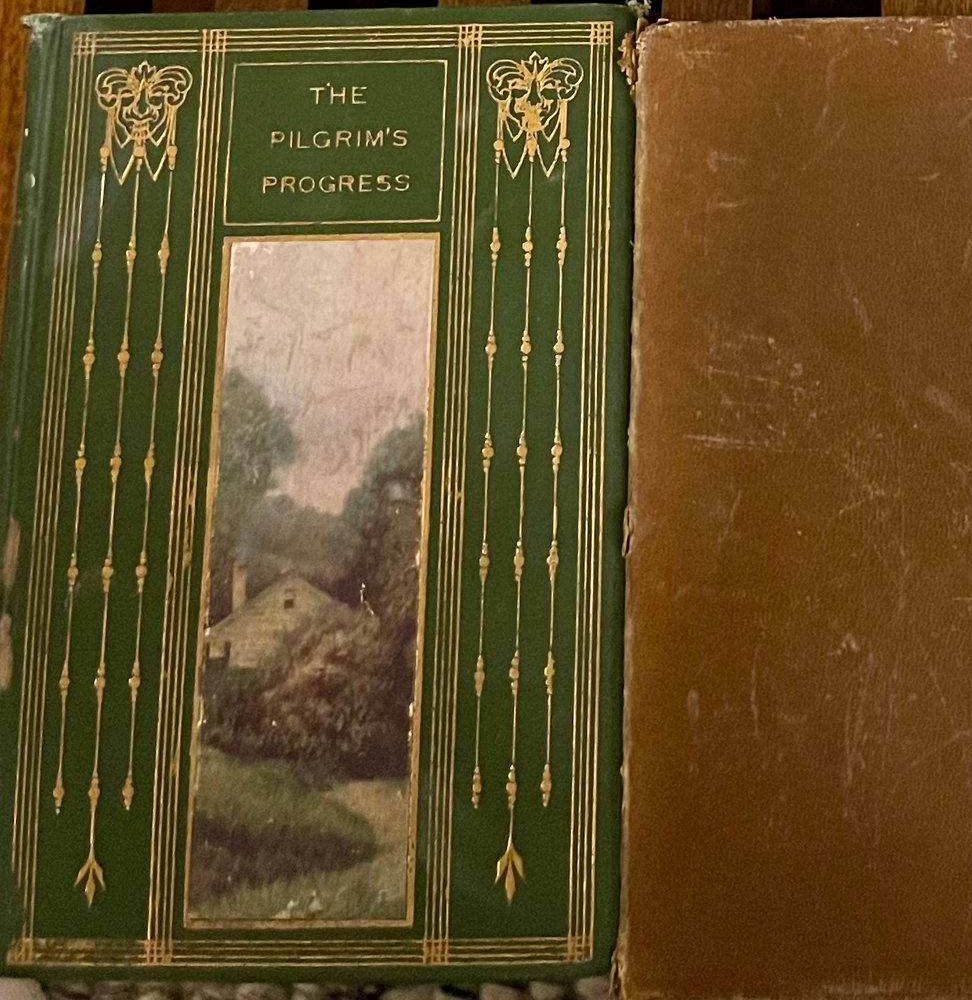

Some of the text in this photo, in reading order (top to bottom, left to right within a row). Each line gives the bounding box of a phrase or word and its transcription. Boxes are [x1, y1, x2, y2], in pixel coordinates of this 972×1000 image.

[310, 85, 368, 105] THE
[270, 128, 409, 149] PILGRIM'S
[261, 174, 410, 194] PROGRESS
